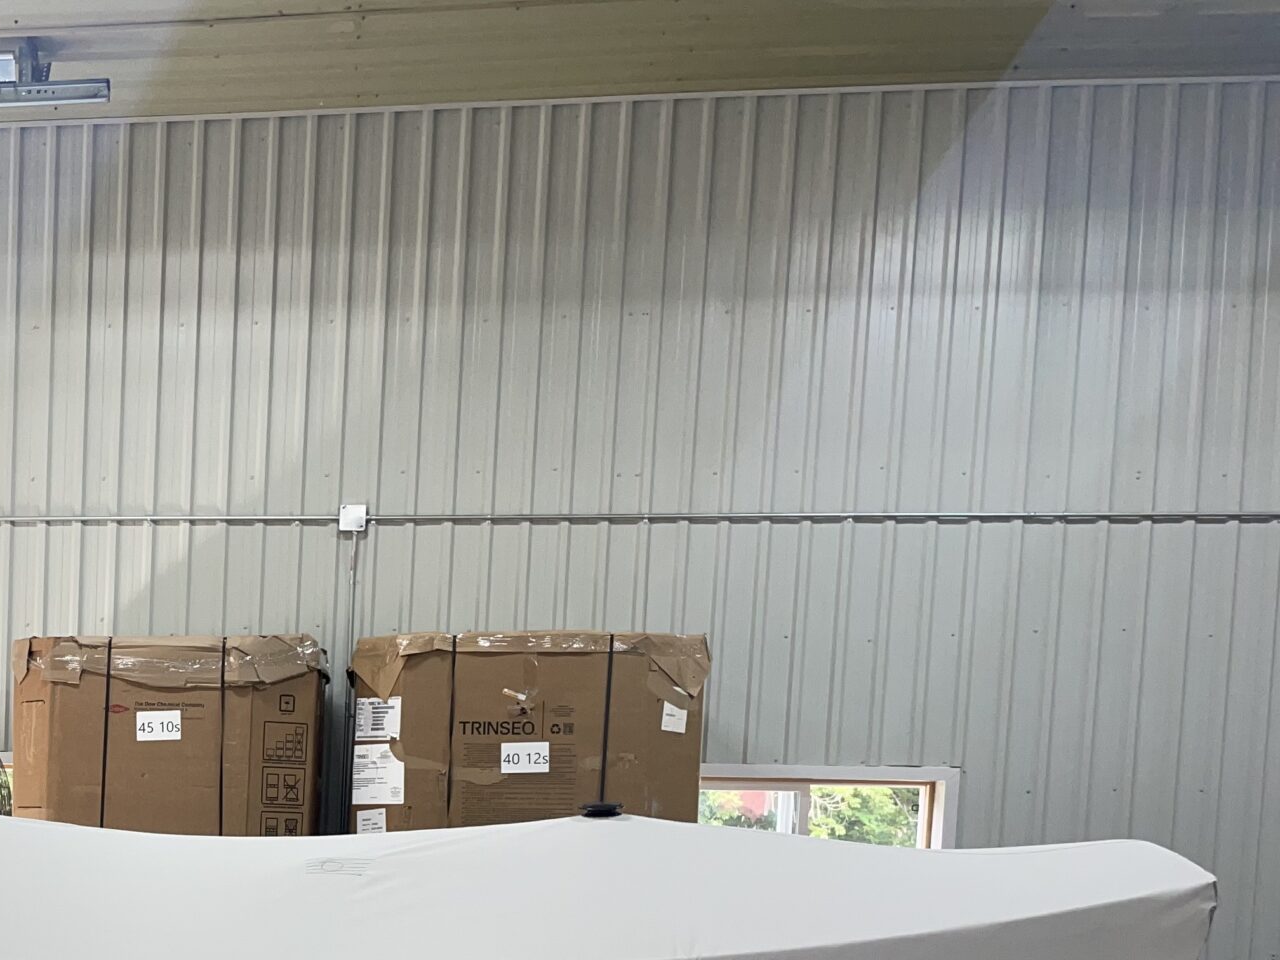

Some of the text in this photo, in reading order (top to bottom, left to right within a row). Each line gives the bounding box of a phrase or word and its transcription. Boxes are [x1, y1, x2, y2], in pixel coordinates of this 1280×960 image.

[138, 721, 180, 733] 45 10s
[459, 721, 535, 735] TRINSEO
[503, 753, 520, 765] 40
[526, 752, 549, 765] 12s
